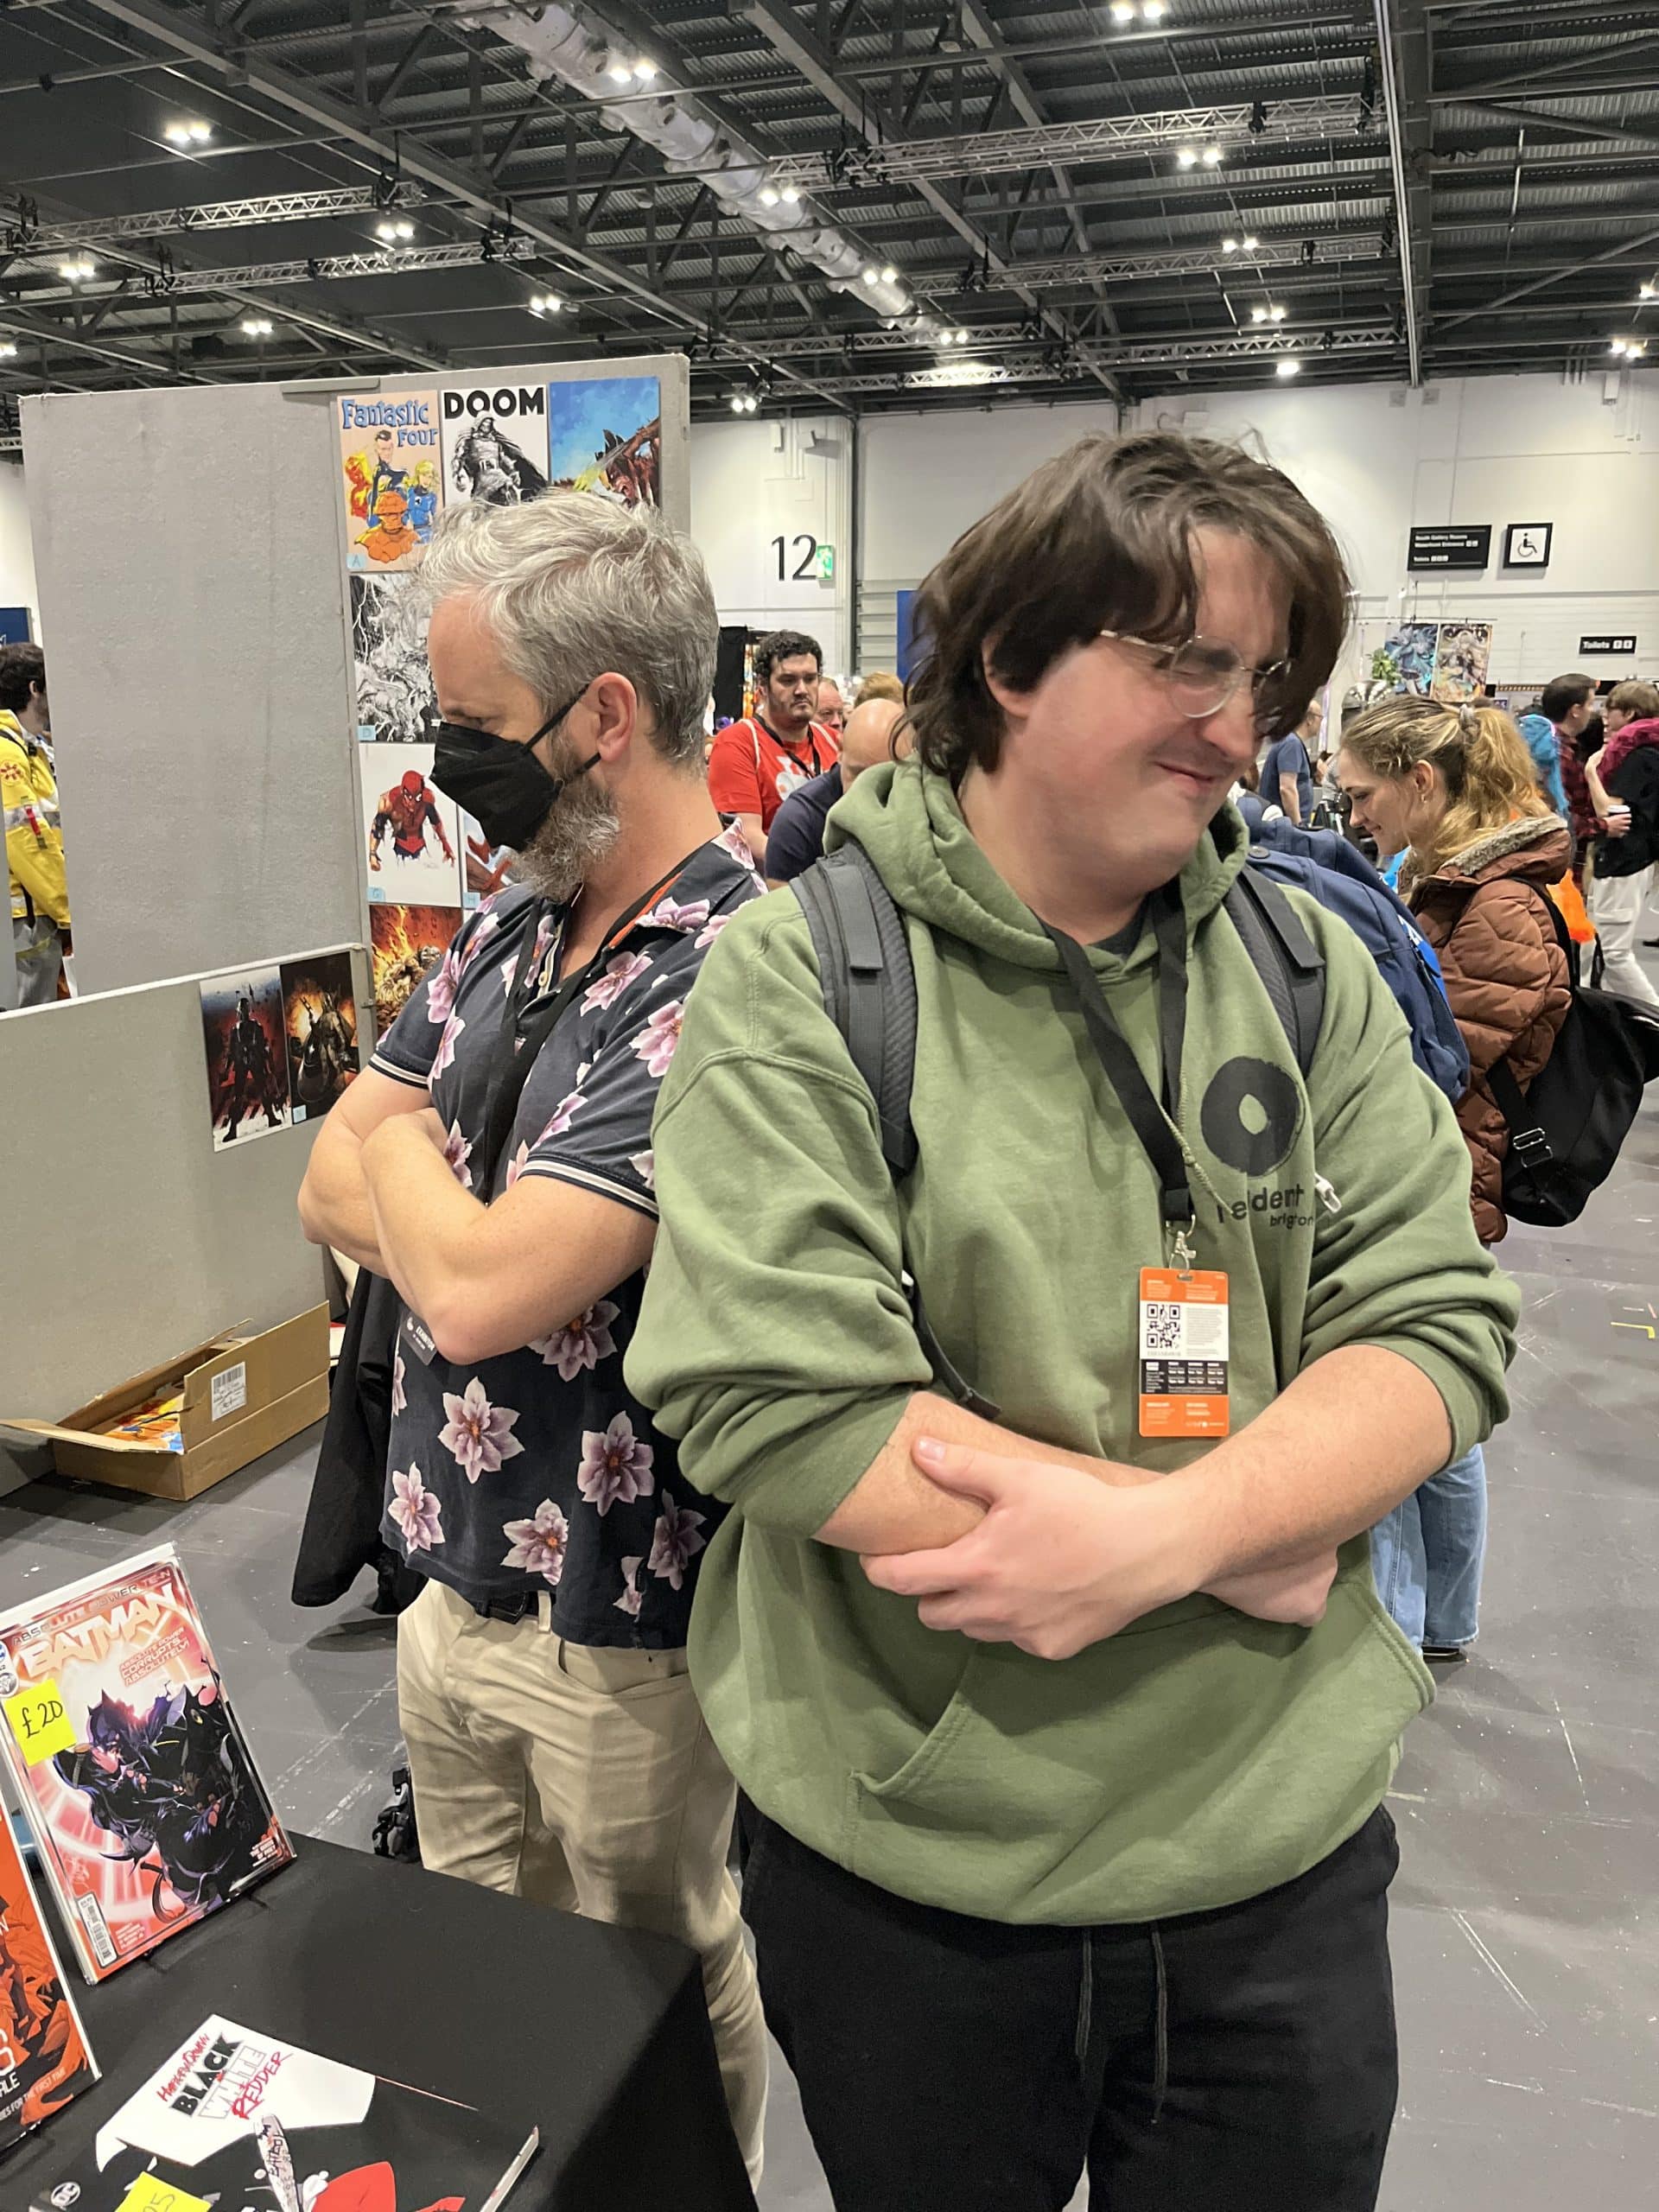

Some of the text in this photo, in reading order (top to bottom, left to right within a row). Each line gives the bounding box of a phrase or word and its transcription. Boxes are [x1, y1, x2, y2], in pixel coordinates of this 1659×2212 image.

[341, 398, 429, 429] Fantastic
[444, 387, 544, 420] DOOM
[772, 534, 817, 582] 12
[362, 727, 372, 738] D
[18, 1583, 174, 1678] BATMAN
[22, 1700, 64, 1738] £20
[169, 2033, 244, 2117] BLACK
[198, 2044, 268, 2119] WHITE
[231, 2050, 294, 2120] REDDER
